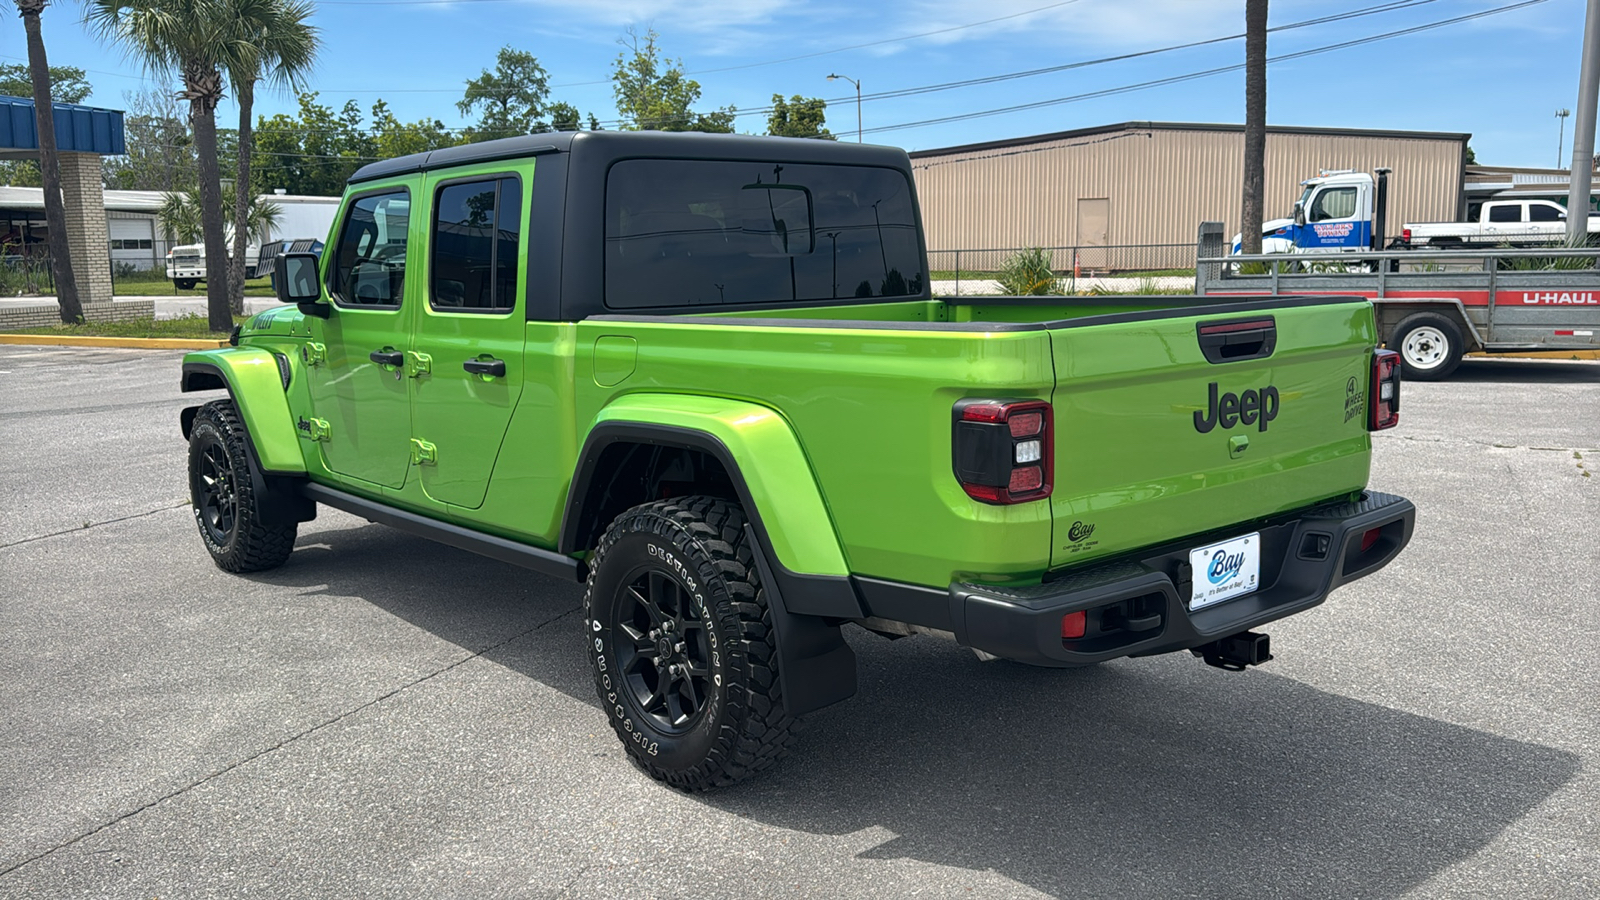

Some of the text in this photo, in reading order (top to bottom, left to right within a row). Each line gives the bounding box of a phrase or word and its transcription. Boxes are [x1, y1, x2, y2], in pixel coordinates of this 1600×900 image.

[1523, 292, 1598, 304] U-HAUL
[1193, 382, 1280, 433] Jeep
[1344, 391, 1364, 411] WHEEL
[1344, 402, 1363, 424] DRIVE
[1068, 520, 1096, 541] Bay
[1210, 549, 1246, 578] Bay
[648, 543, 721, 667] DESTINATION
